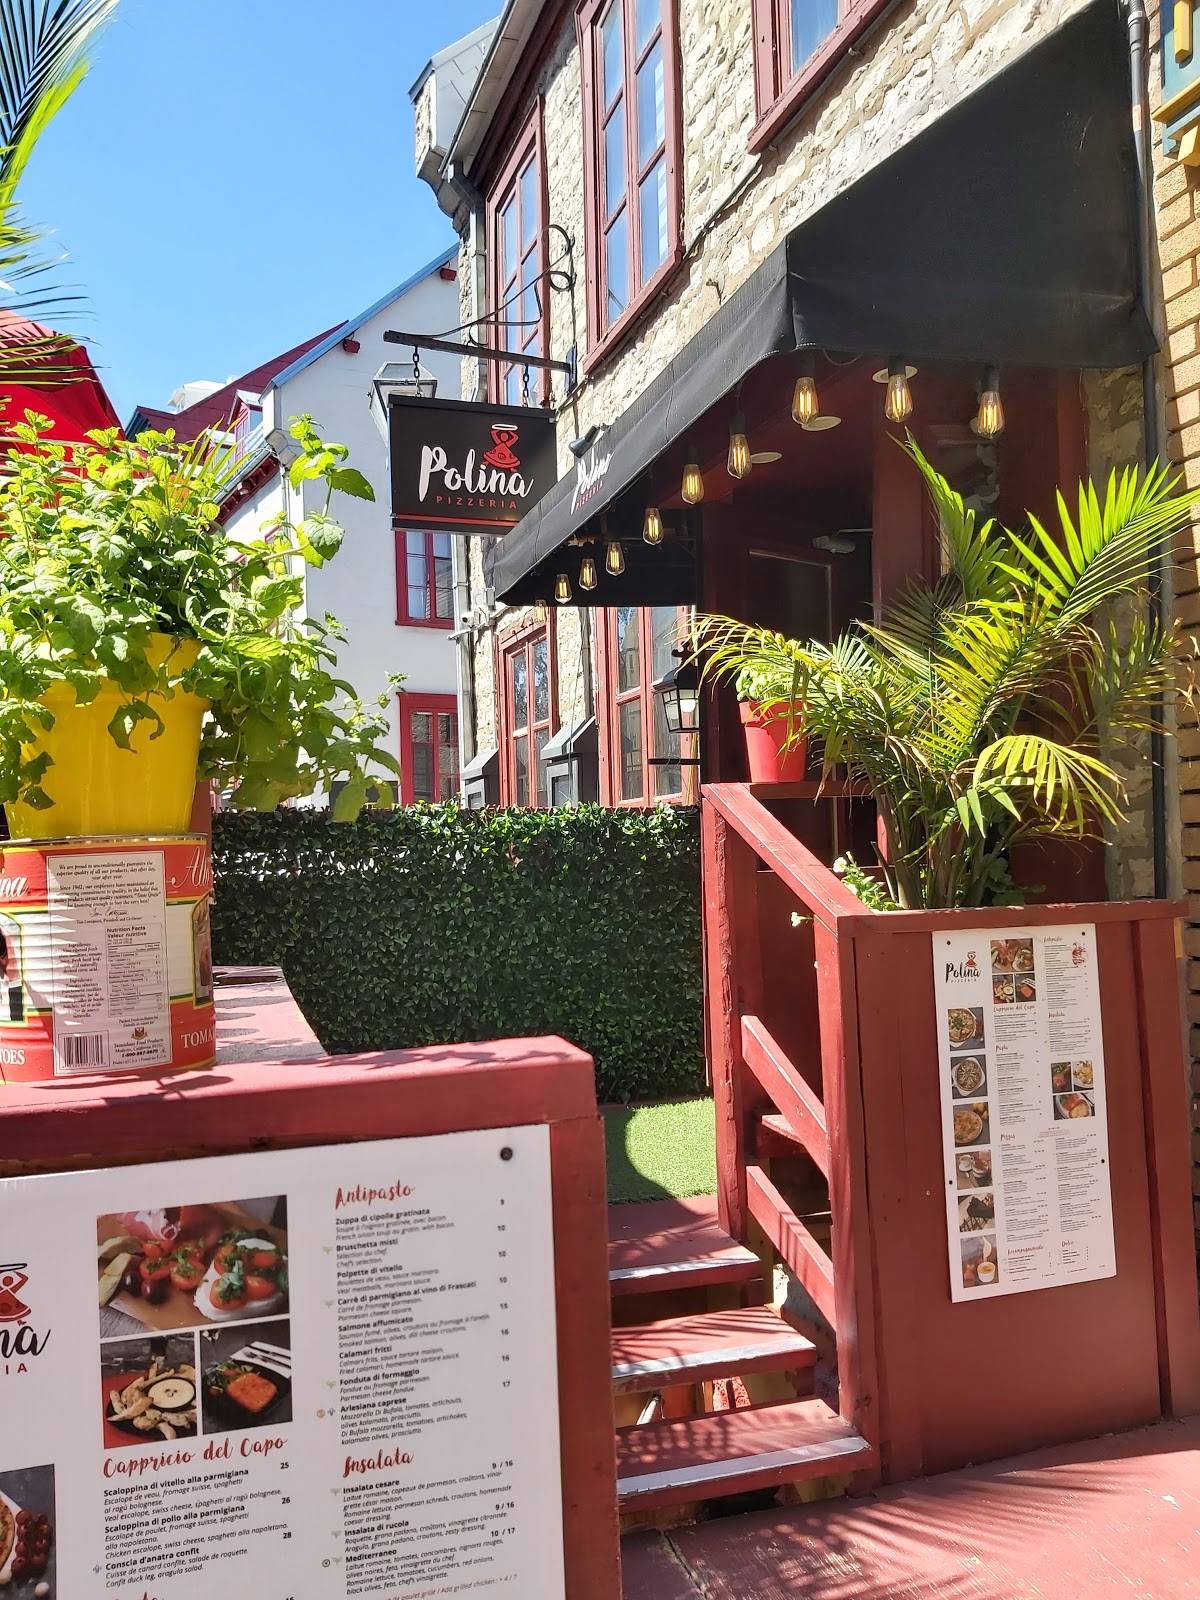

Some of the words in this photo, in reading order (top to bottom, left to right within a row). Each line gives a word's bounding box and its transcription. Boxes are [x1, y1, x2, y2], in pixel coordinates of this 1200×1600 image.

[419, 446, 534, 502] Polina
[570, 449, 615, 515] Polina
[436, 495, 517, 509] PIZZERIA
[575, 481, 604, 511] PIZZERIA
[946, 962, 981, 983] Polina
[335, 1179, 415, 1210] Antipasto
[103, 1451, 196, 1478] Cappricio
[204, 1438, 233, 1460] del
[240, 1438, 288, 1457] Capo
[343, 1447, 414, 1478] Insalata
[104, 1484, 149, 1497] Scaloppina
[150, 1481, 158, 1490] di
[160, 1478, 186, 1488] vitello
[187, 1475, 202, 1484] alla
[204, 1469, 248, 1483] parmigiana
[104, 1521, 150, 1533] Scaloppina
[151, 1517, 160, 1526] di
[161, 1514, 182, 1526] pollo
[183, 1512, 198, 1520] alla
[200, 1505, 245, 1520] parmigiana
[176, 1548, 200, 1558] confit
